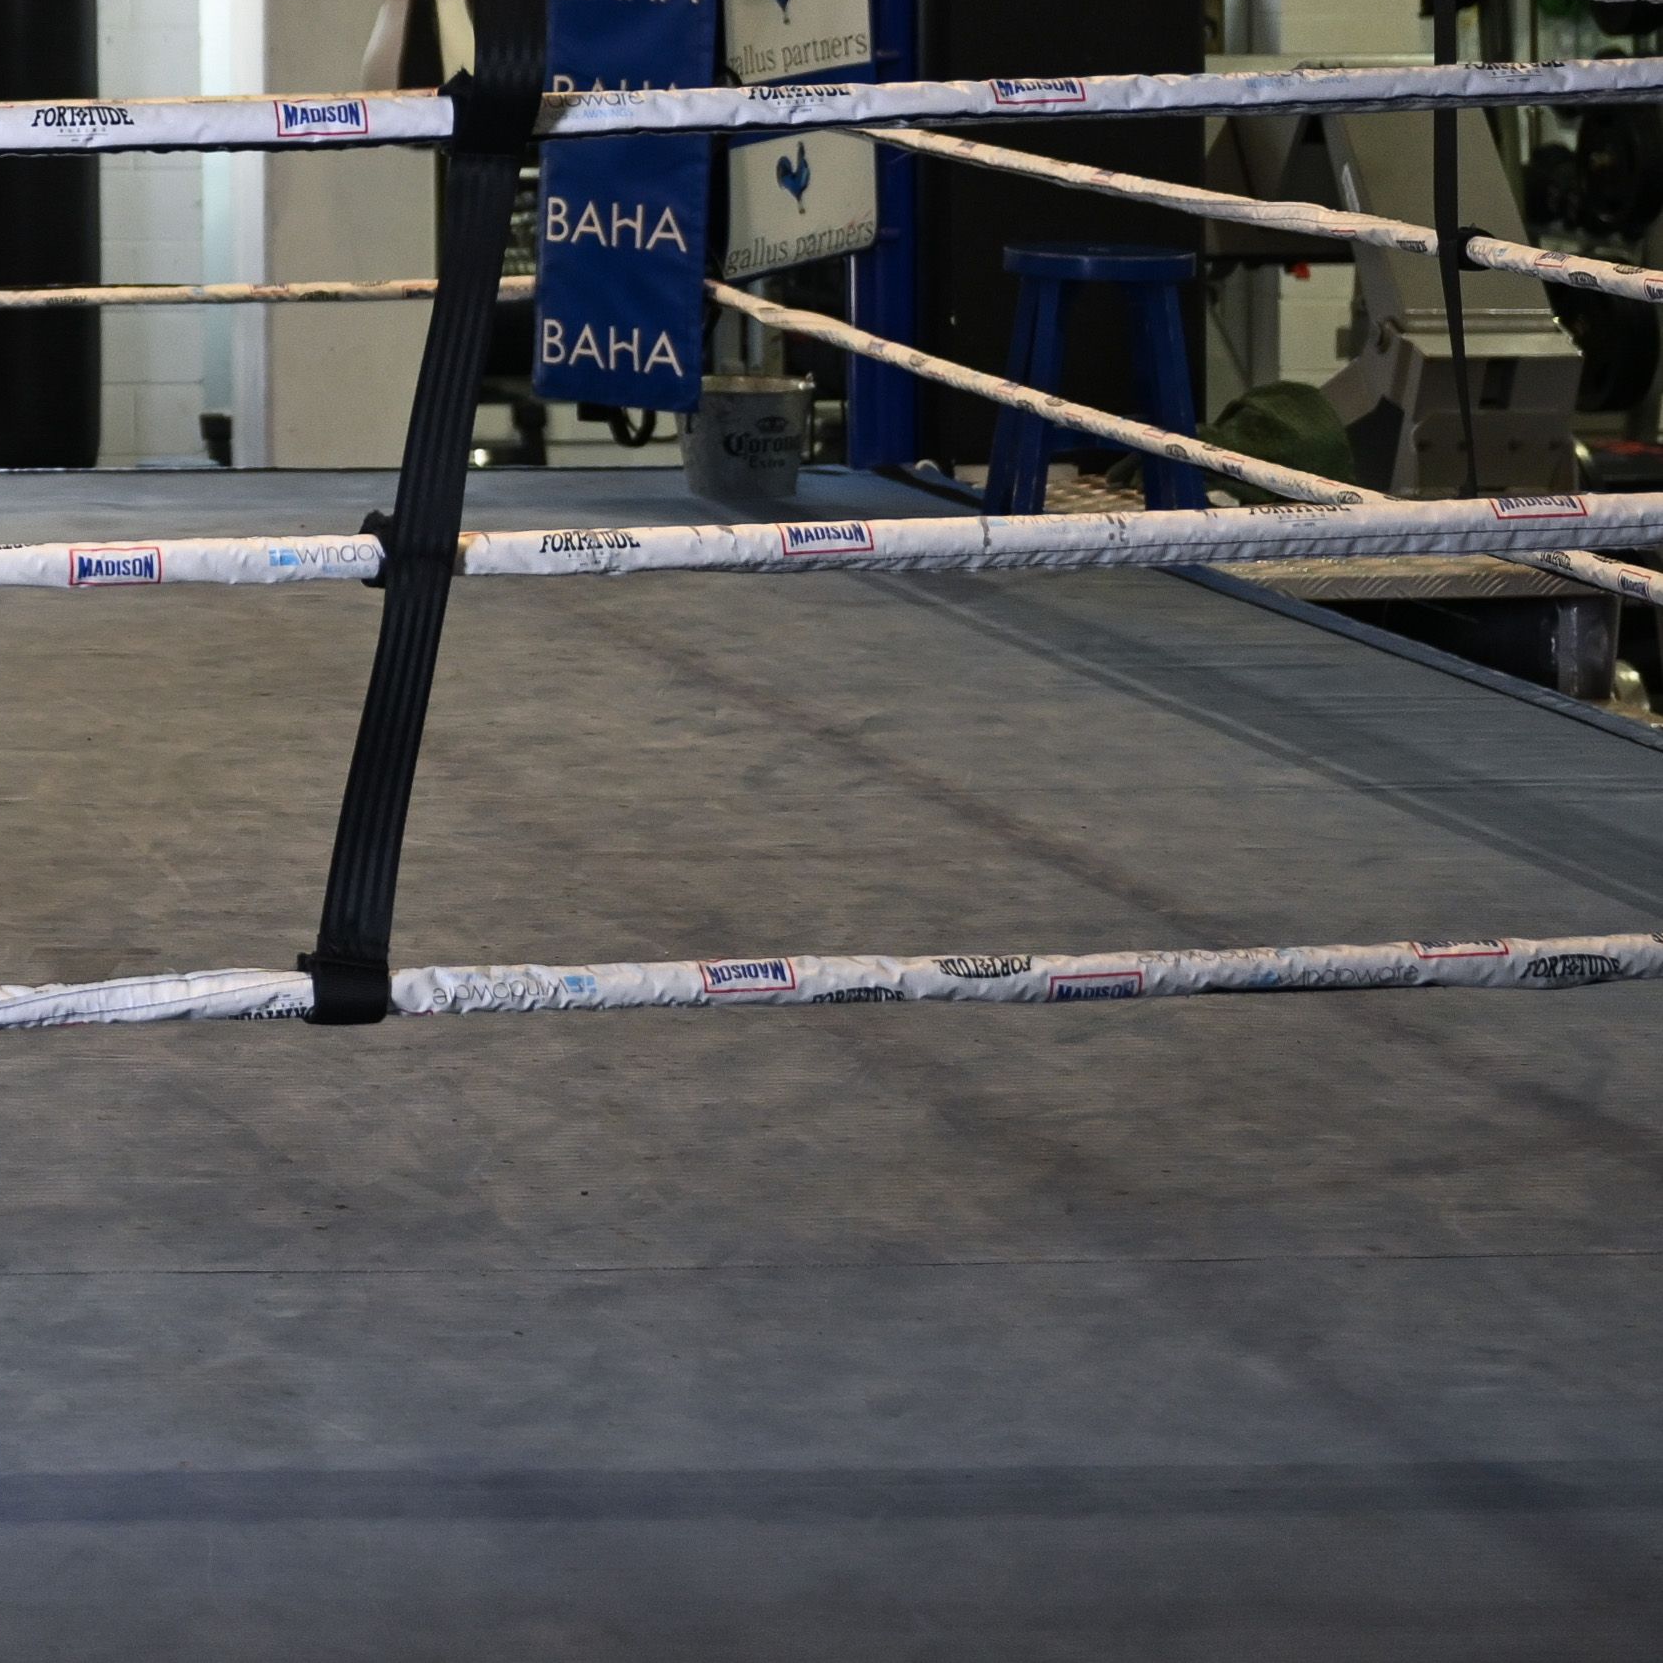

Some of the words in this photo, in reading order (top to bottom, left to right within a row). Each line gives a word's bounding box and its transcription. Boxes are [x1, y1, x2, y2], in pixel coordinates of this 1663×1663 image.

[780, 33, 867, 72] partners
[31, 106, 133, 128] FORTITUDE
[284, 103, 361, 127] MADISON
[547, 197, 686, 252] BAHA
[727, 238, 787, 274] gallus
[796, 214, 874, 261] partners
[543, 318, 681, 376] BAHA
[788, 522, 865, 546] MADISON
[77, 555, 154, 581] MADISON
[708, 959, 787, 986] MADISON
